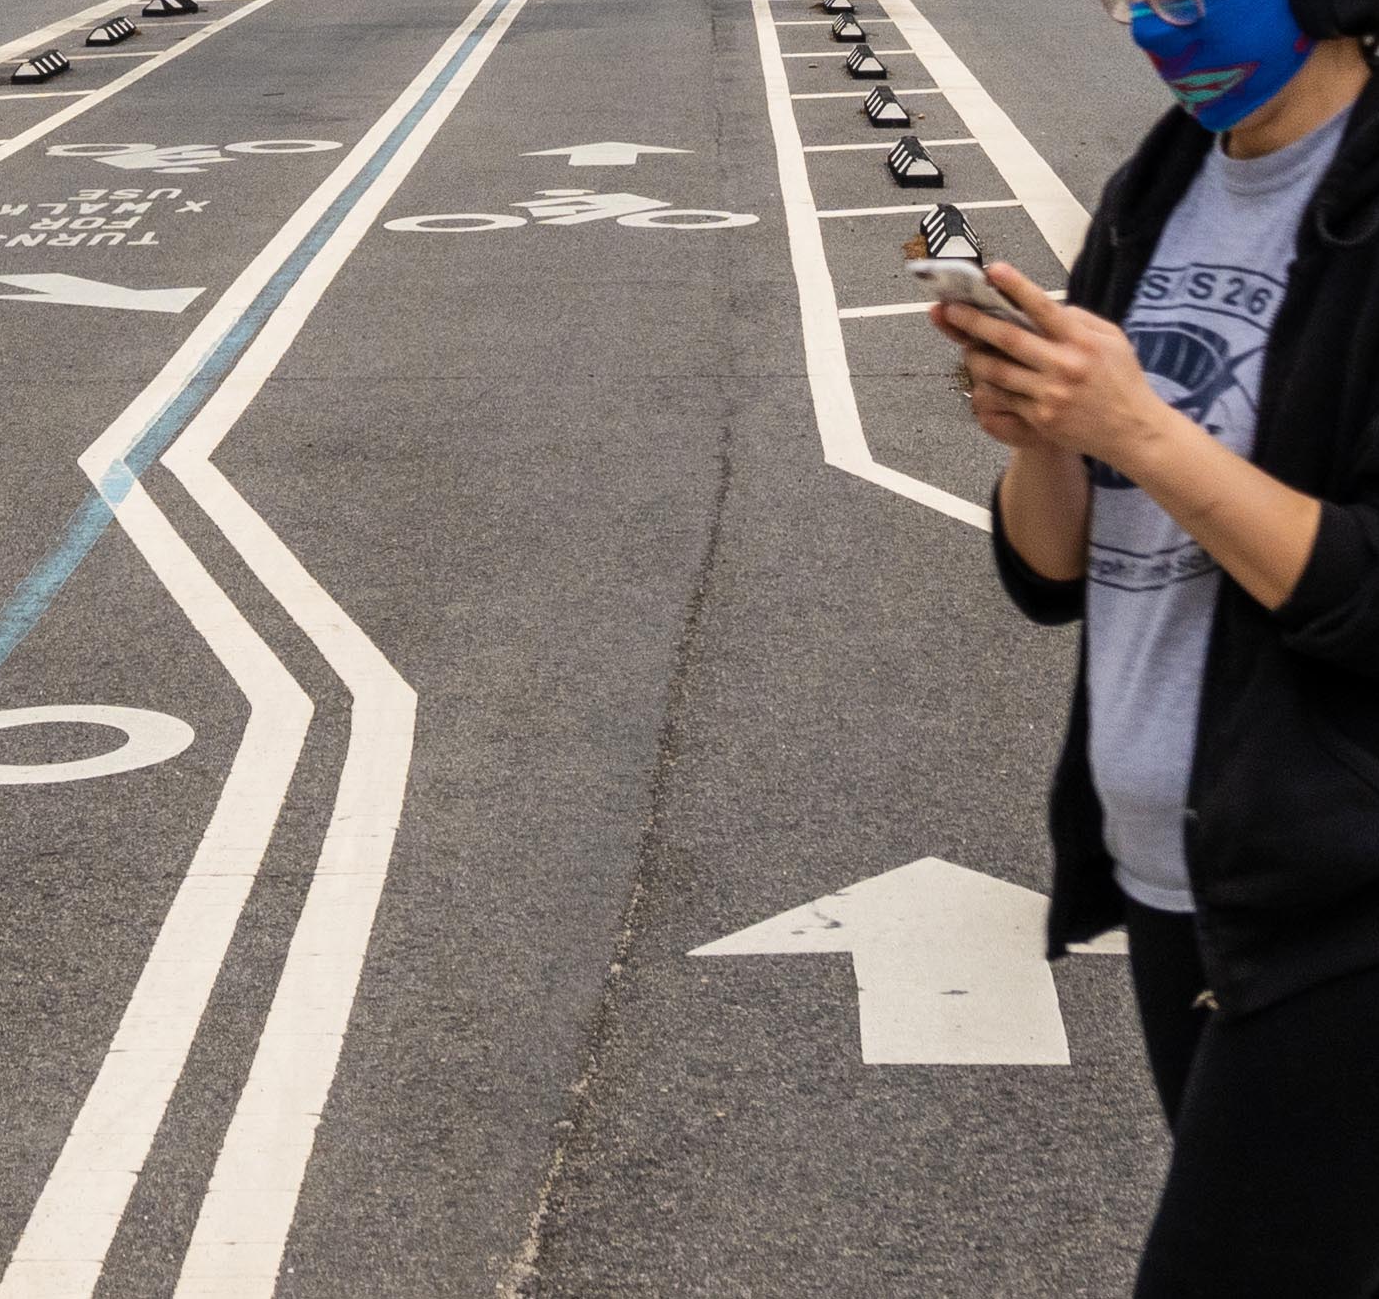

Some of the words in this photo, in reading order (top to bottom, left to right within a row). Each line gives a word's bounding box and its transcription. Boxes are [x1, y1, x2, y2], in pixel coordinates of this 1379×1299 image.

[68, 188, 182, 200] USE
[175, 200, 211, 213] X
[29, 216, 142, 229] FOR
